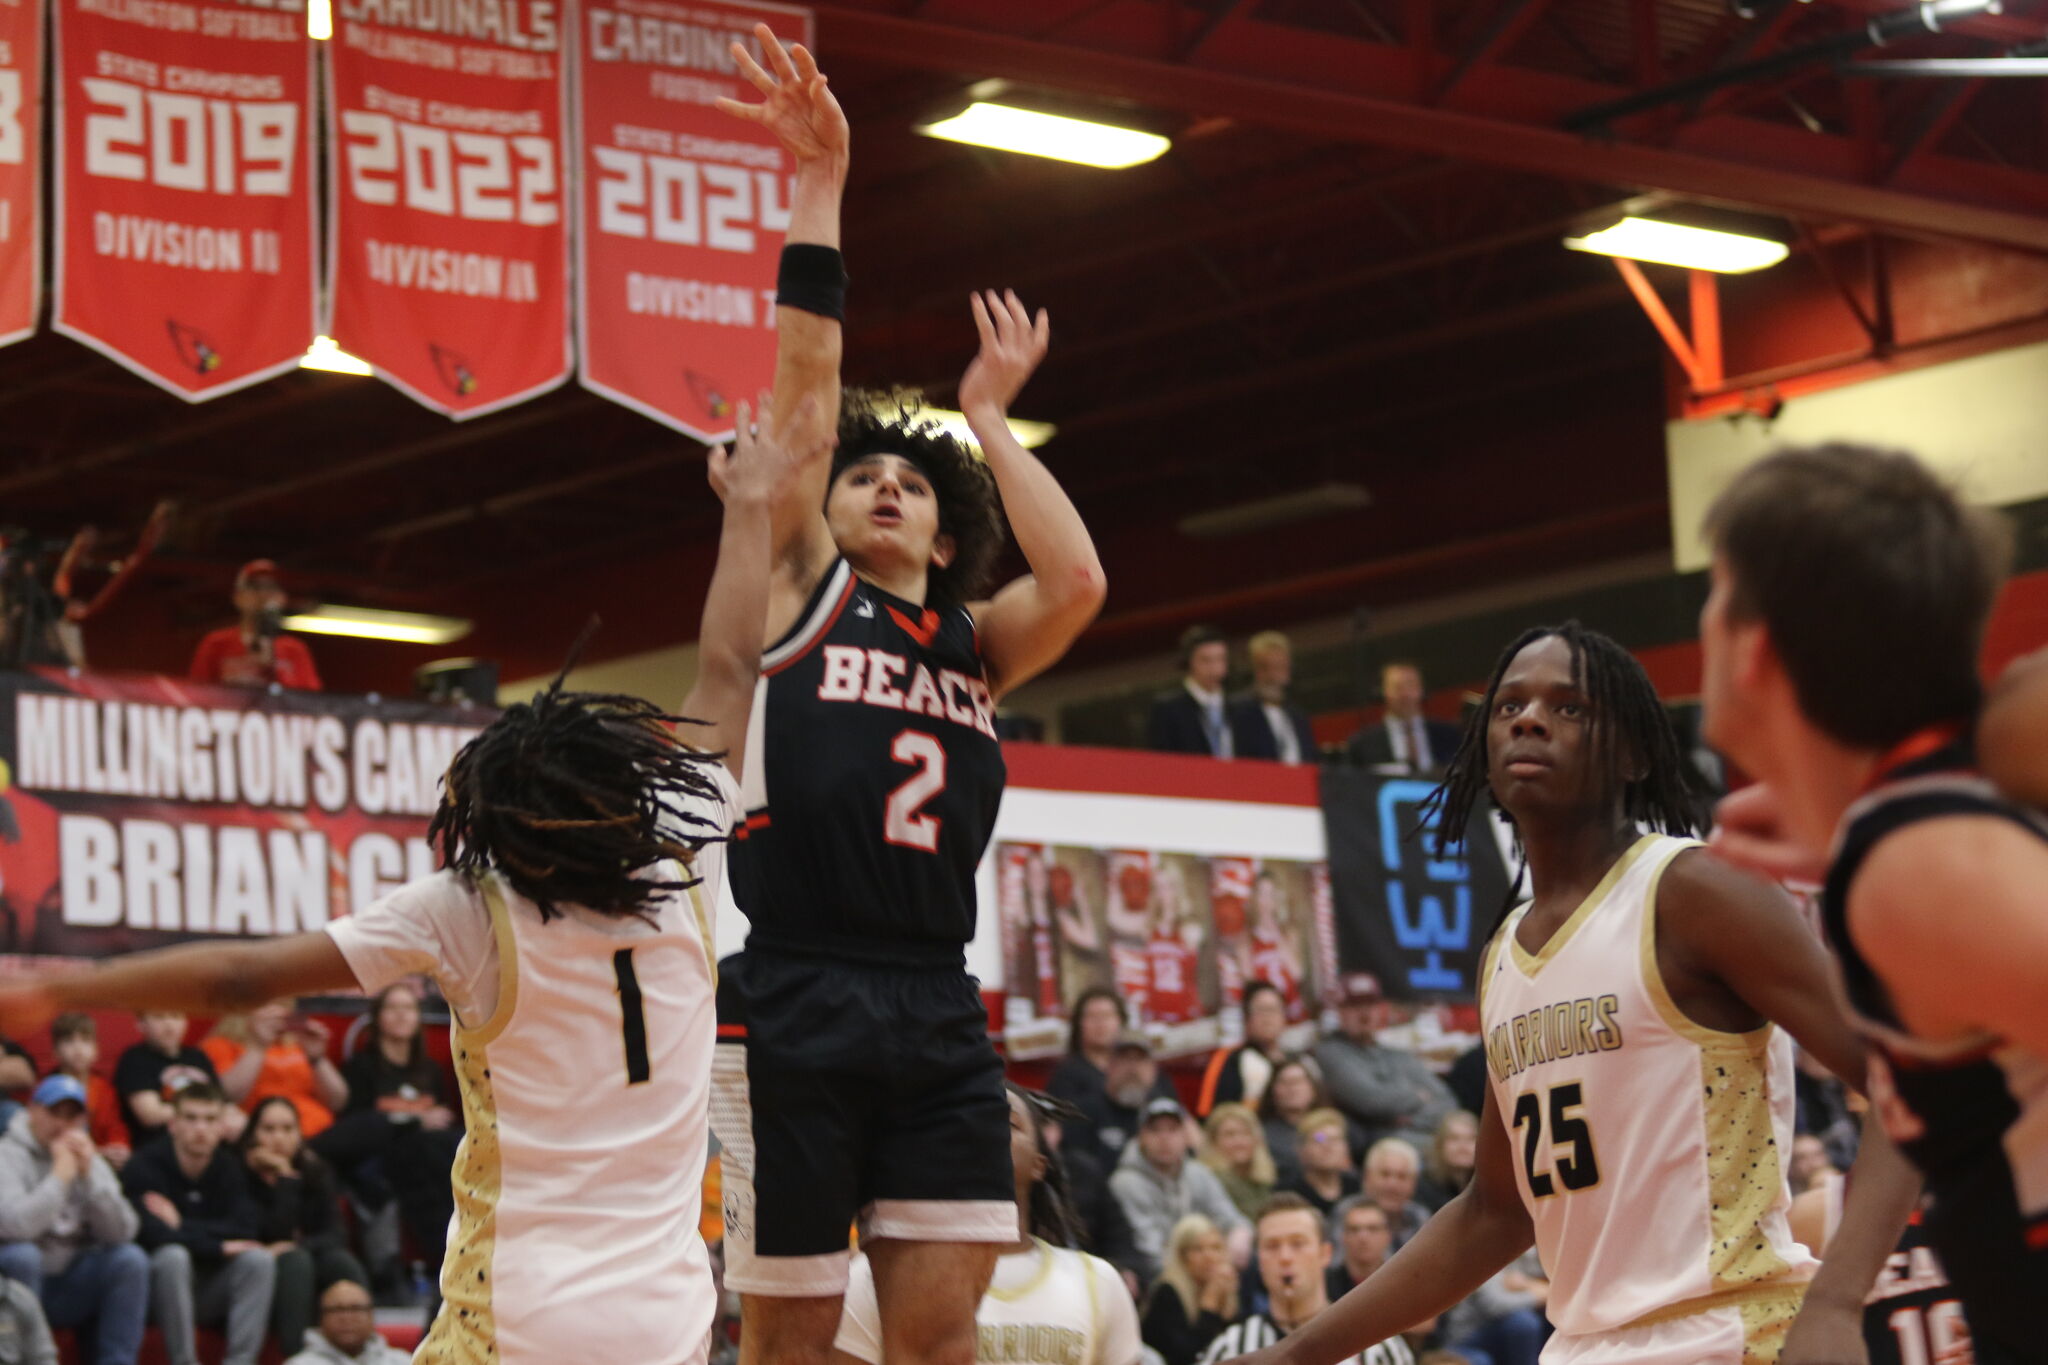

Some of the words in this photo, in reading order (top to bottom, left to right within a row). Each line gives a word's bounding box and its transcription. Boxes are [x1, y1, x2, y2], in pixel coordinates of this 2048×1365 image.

[97, 50, 159, 87] STATE
[164, 65, 282, 99] CHAMPIONS
[364, 84, 421, 121] STATE
[428, 100, 541, 133] CHAMPIONS
[460, 47, 554, 80] SOFTBALL
[82, 77, 298, 196] 2019
[342, 110, 559, 226] 2022
[613, 123, 674, 153] STATE
[678, 134, 783, 170] CHAMPIONS
[95, 211, 242, 271] DIVISION
[592, 145, 797, 253] 2024
[366, 239, 502, 297] DIVISION
[626, 271, 756, 327] DIVISION
[17, 693, 348, 812] MILLINGTON'S
[883, 728, 948, 854] 2
[60, 812, 329, 936] BRIAN
[612, 946, 652, 1087] 1
[1511, 1078, 1603, 1199] 25
